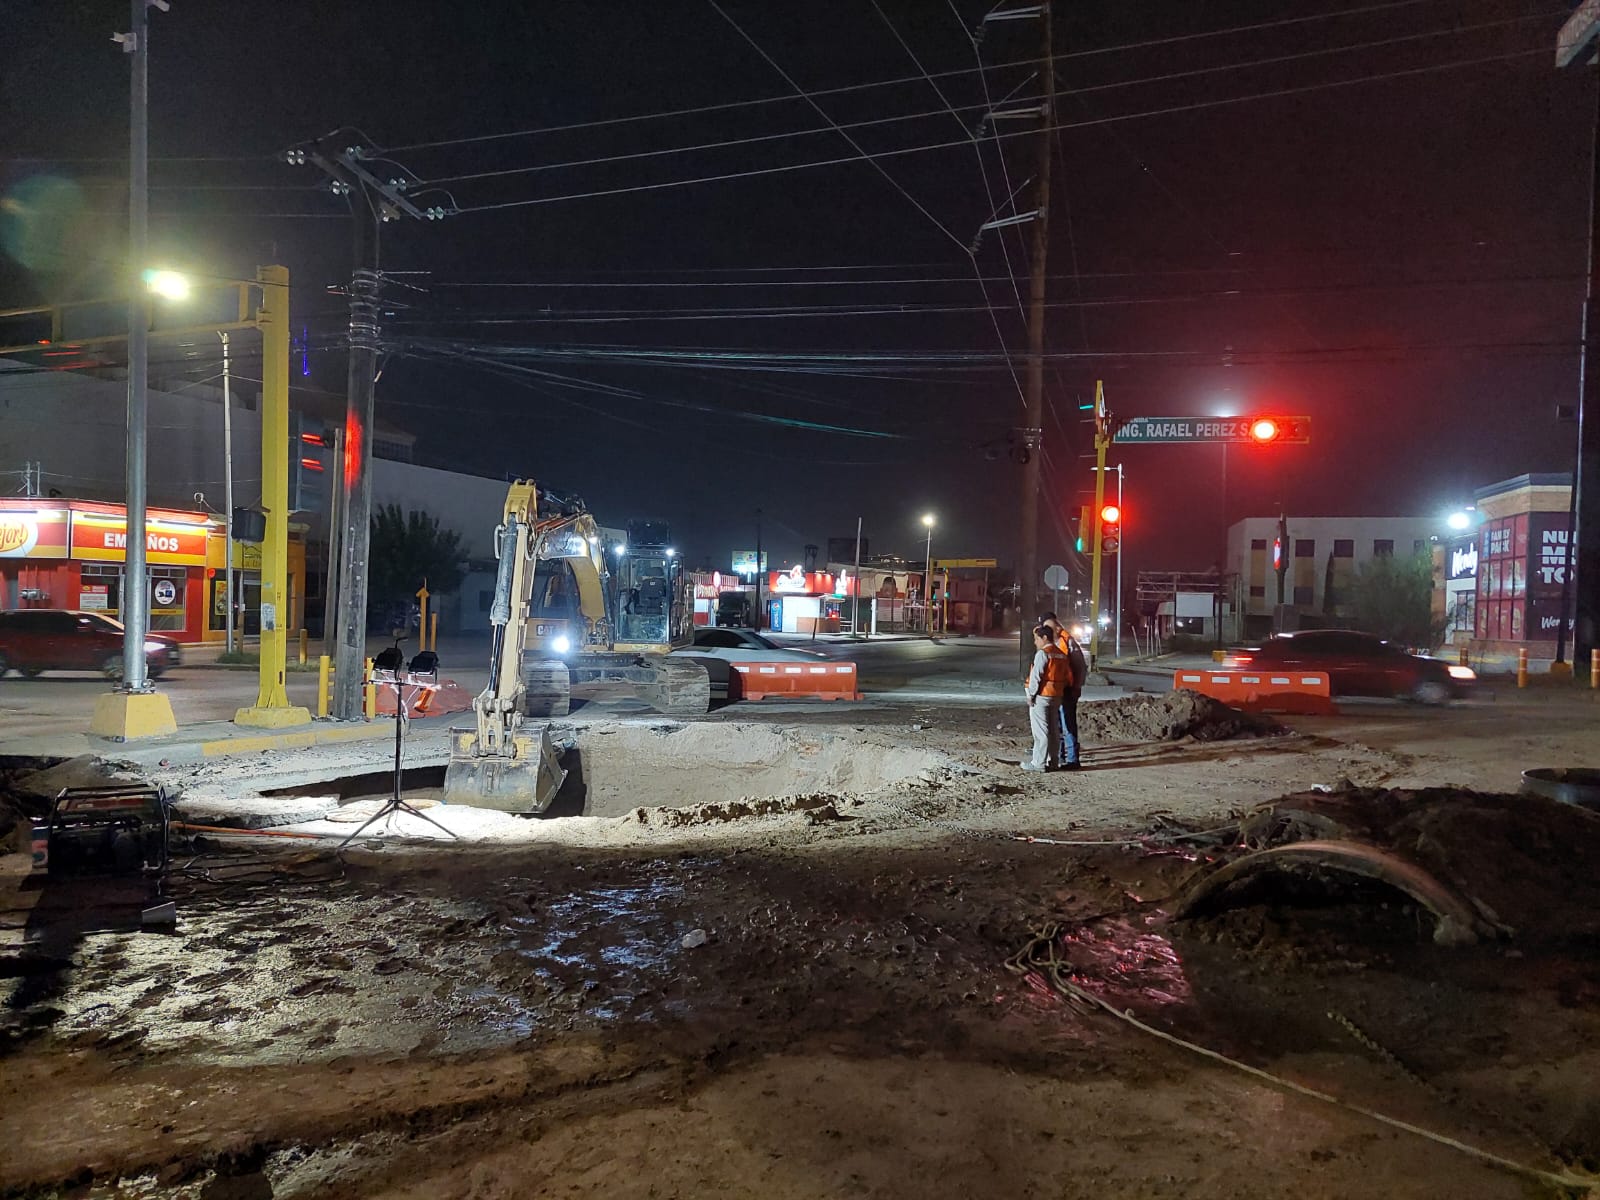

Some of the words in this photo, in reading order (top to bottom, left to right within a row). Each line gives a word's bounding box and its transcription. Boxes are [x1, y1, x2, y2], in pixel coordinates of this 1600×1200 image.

[1146, 423, 1193, 437] RAFAEL
[1196, 422, 1237, 437] PEREZ
[104, 532, 179, 552] EMÑOS
